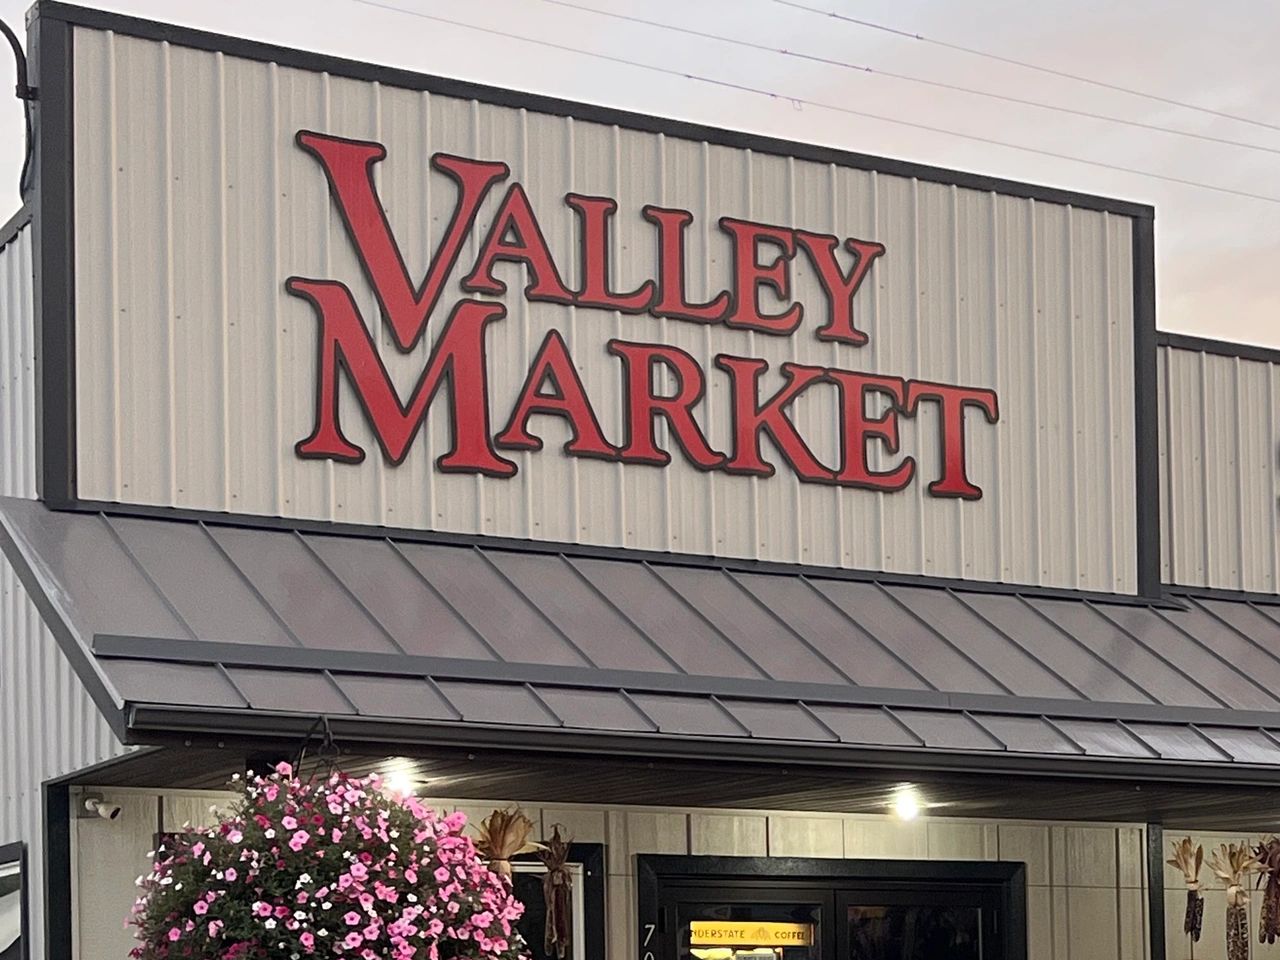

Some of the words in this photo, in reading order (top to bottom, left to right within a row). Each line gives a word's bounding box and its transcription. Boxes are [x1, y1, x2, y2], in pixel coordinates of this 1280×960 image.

[295, 129, 886, 348] VALLEY
[286, 275, 1001, 502] MARKET
[774, 931, 805, 940] COFFEE
